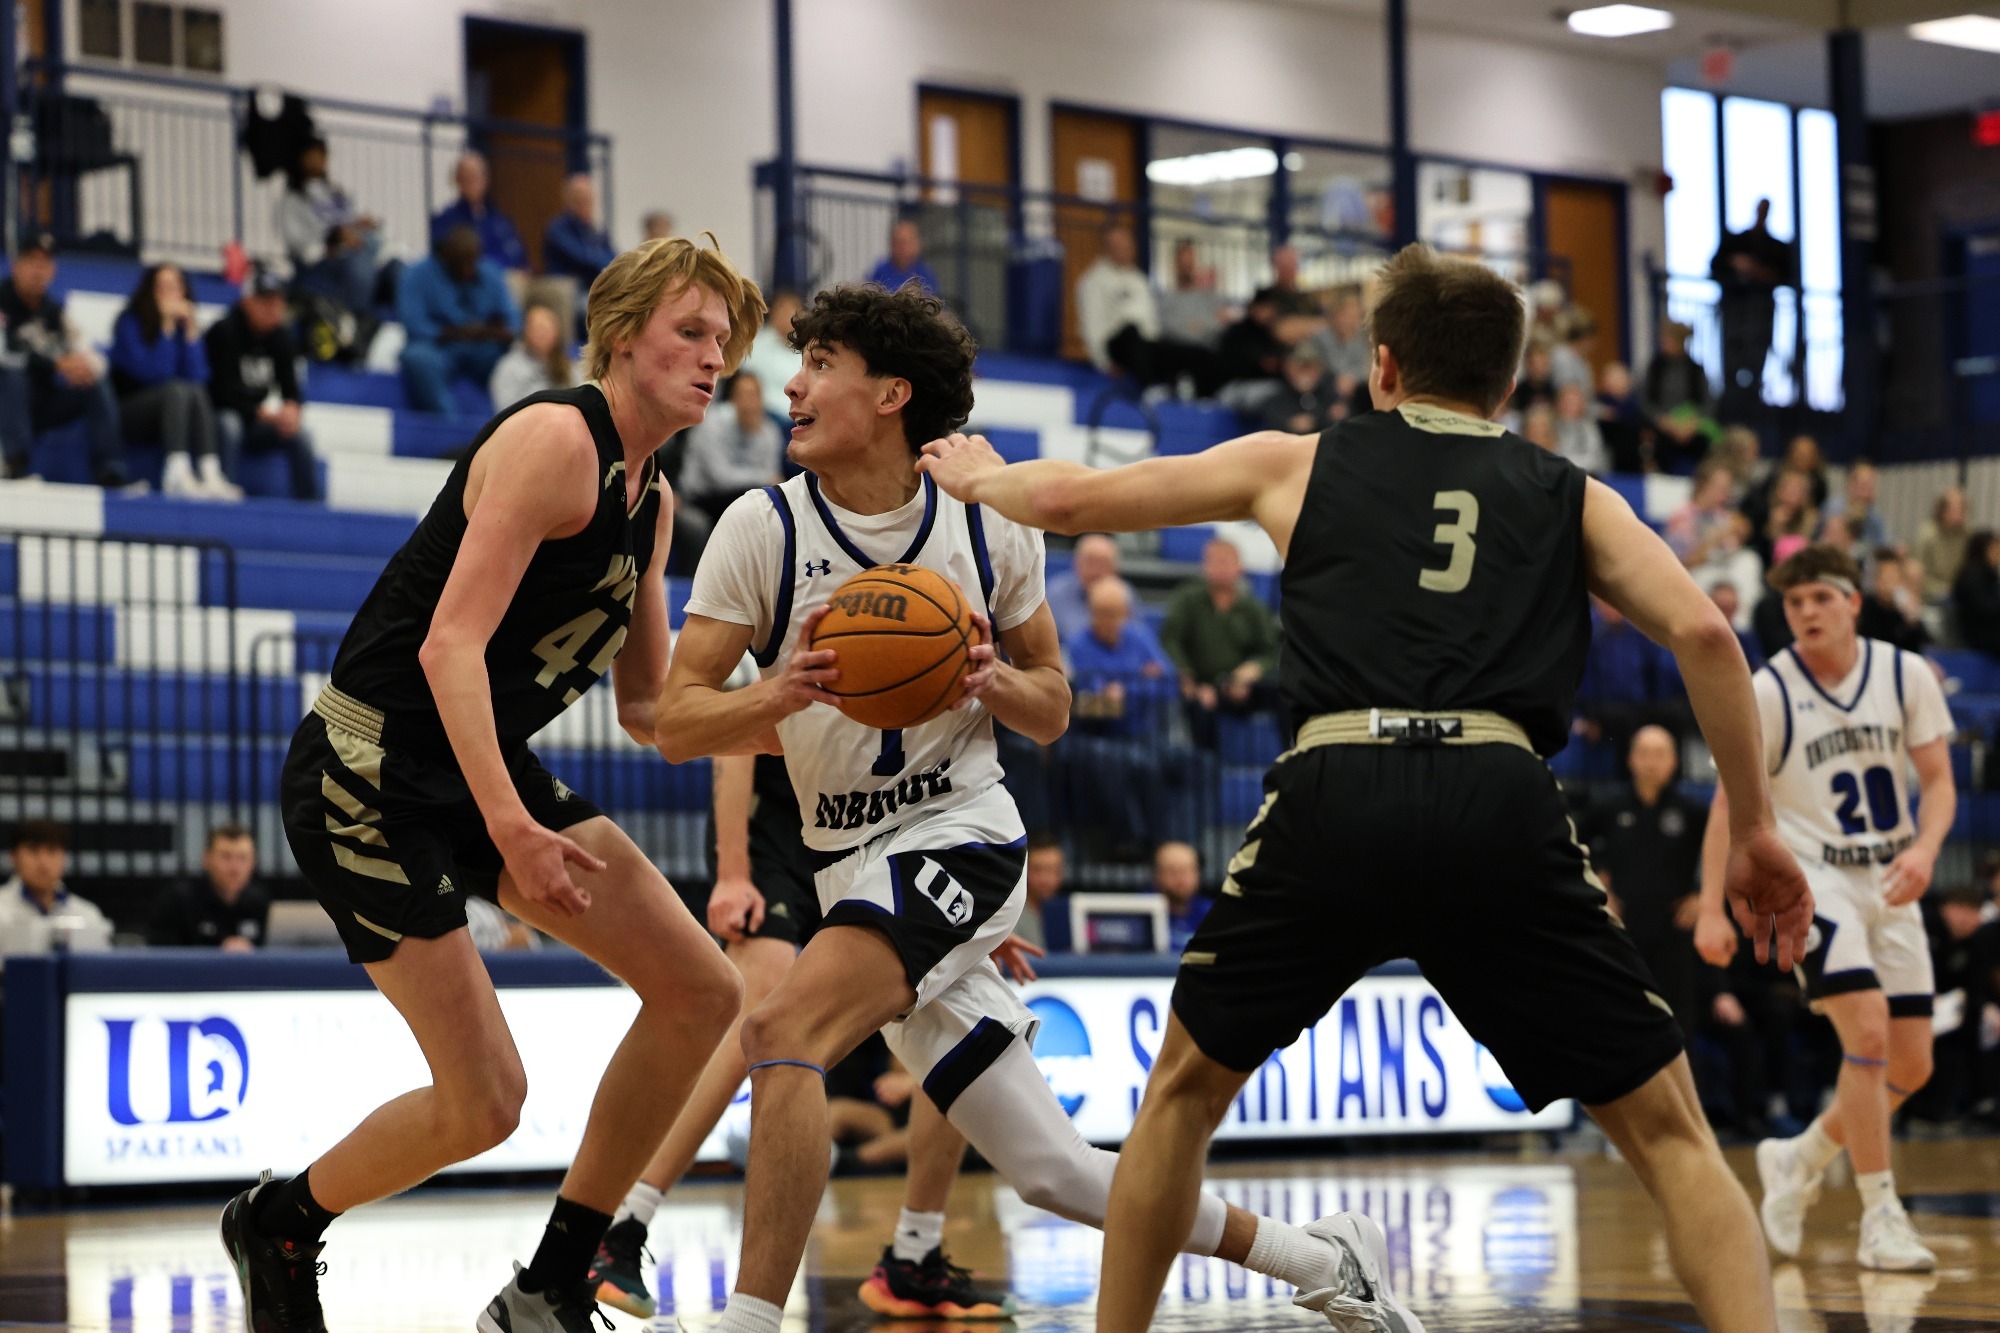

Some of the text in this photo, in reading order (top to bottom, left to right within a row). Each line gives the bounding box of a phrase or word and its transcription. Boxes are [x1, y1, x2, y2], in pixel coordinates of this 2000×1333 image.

[1418, 489, 1479, 593] 3
[1830, 765, 1900, 836] 20
[98, 1015, 250, 1127] UD
[106, 1135, 244, 1164] SPARTANS
